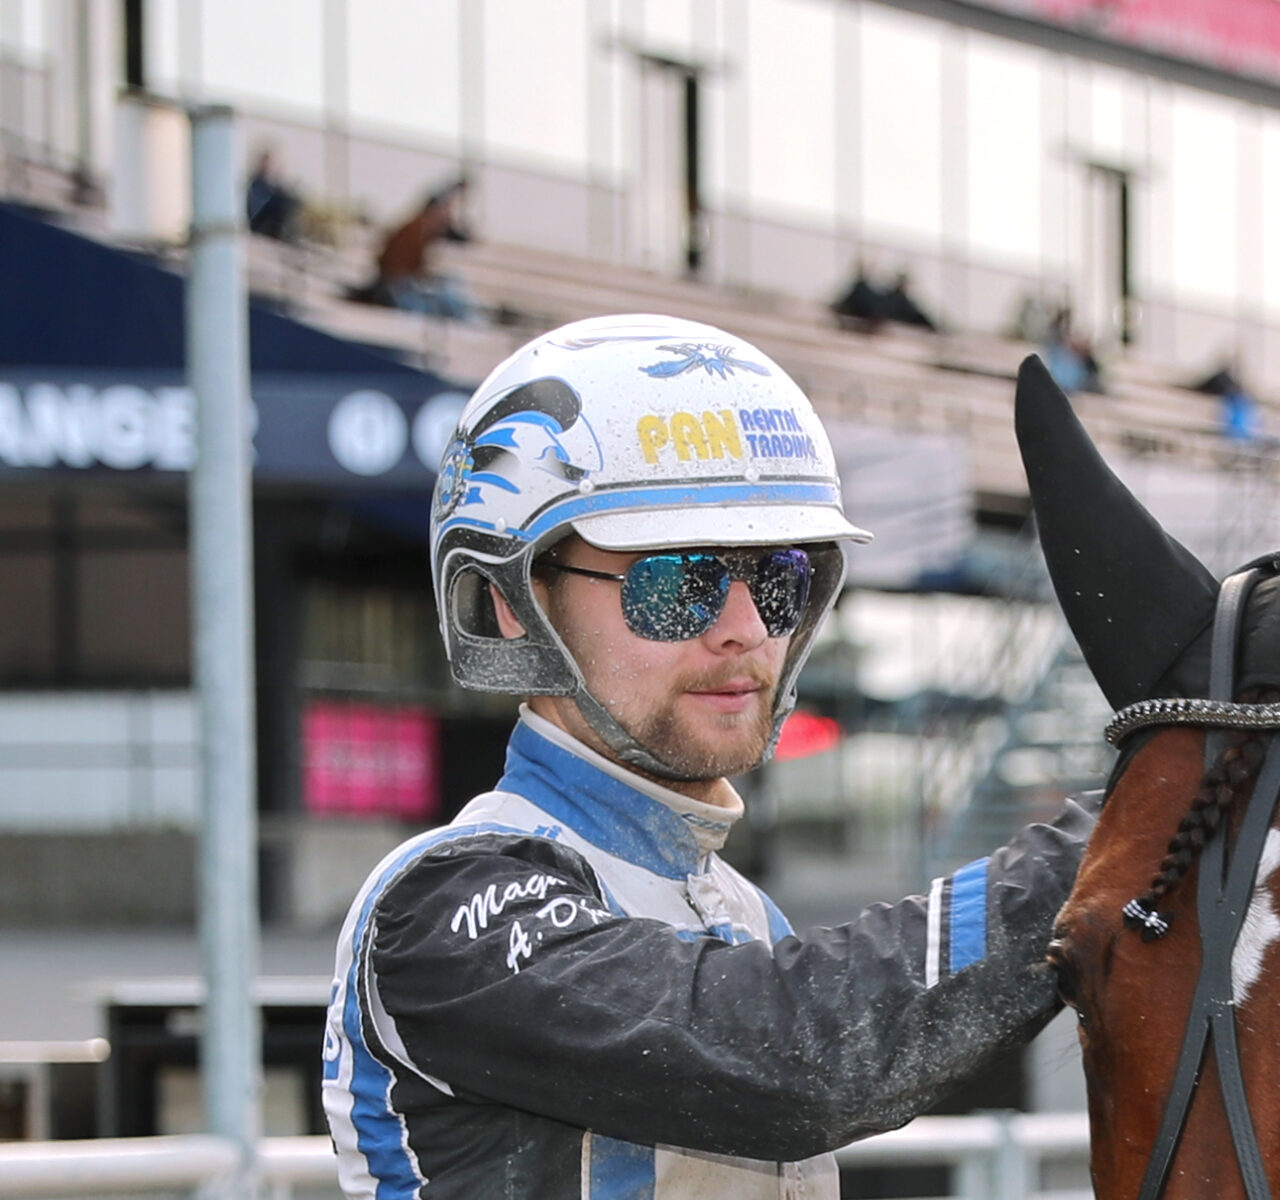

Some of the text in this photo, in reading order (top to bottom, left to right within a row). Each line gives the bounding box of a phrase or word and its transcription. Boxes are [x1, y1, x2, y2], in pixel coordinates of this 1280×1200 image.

[739, 407, 803, 433] RENTAL
[637, 409, 744, 465] PAN
[745, 432, 818, 460] TRADING
